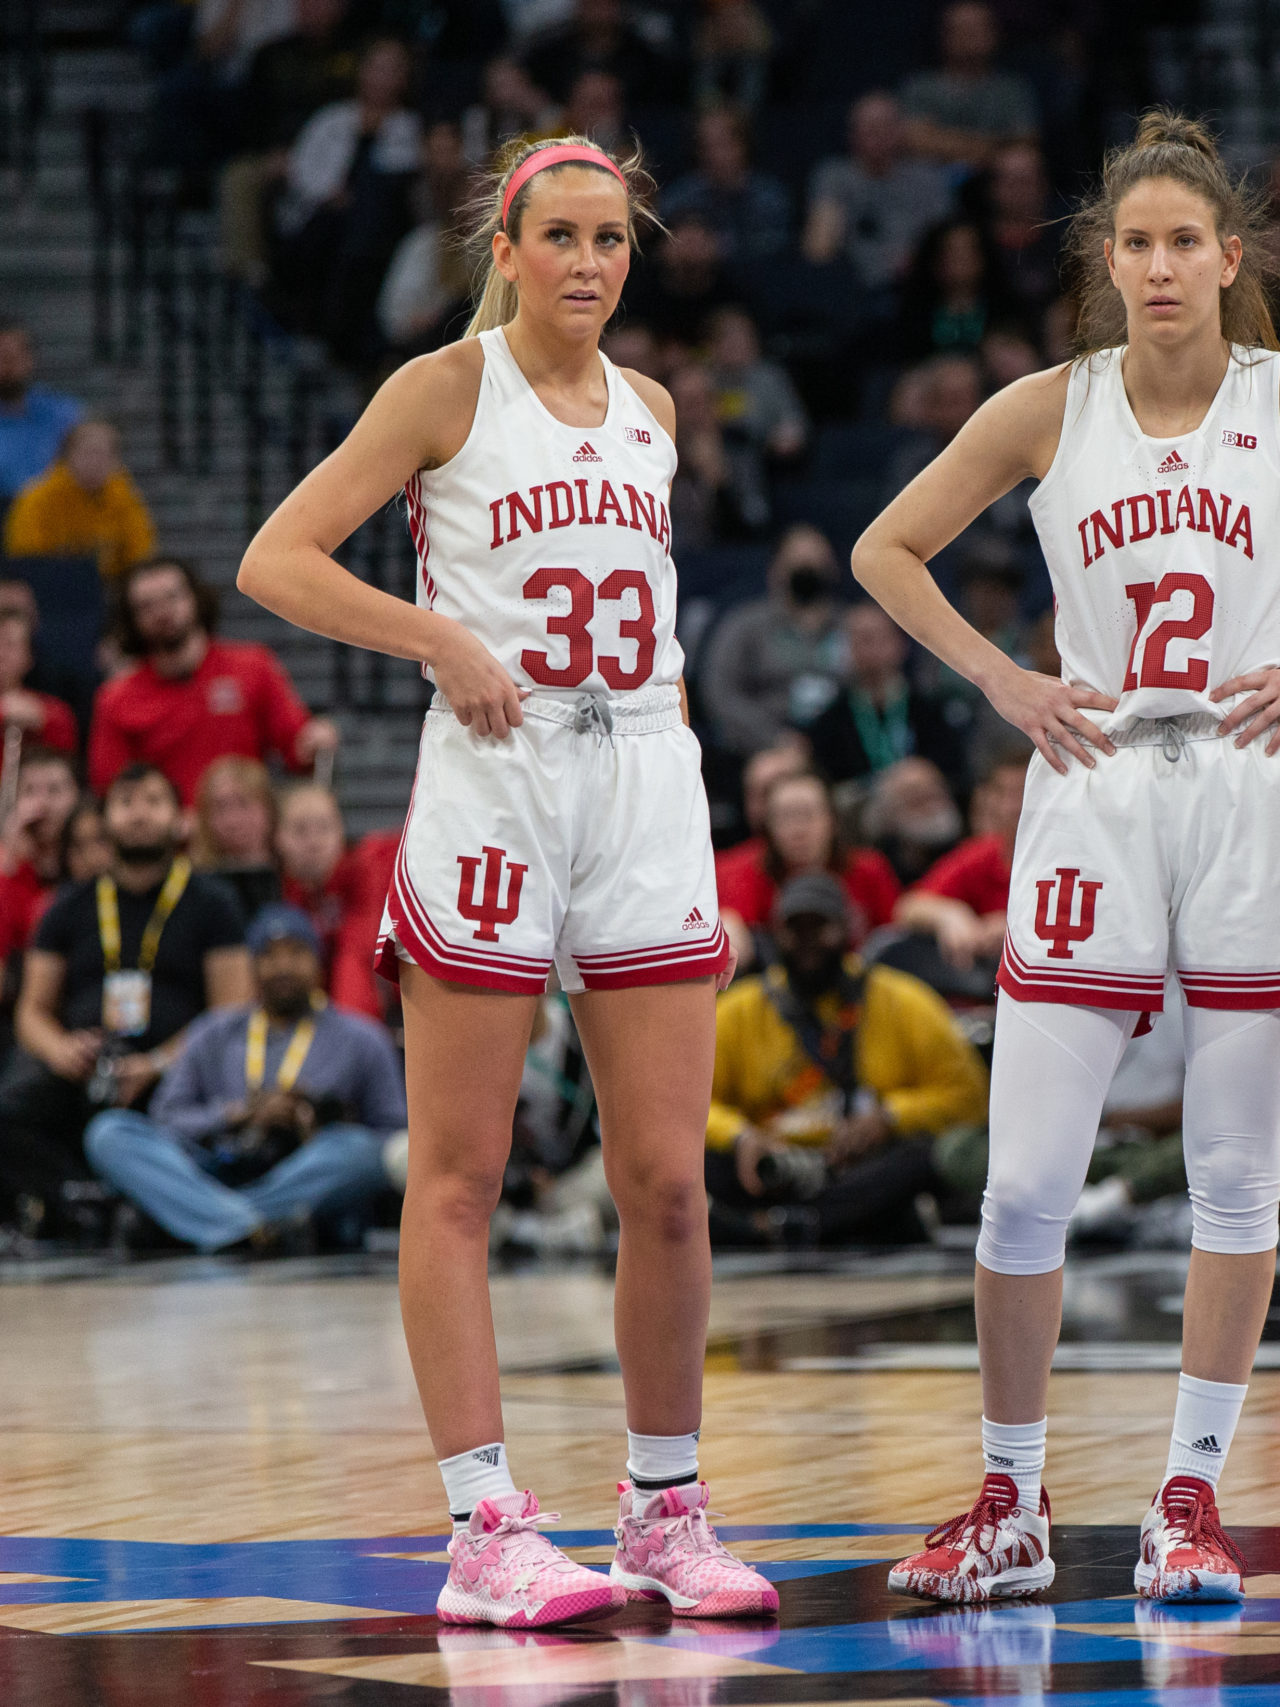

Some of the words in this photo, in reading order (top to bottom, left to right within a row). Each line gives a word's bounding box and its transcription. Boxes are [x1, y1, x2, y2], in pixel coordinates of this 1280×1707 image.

[572, 454, 603, 462] adidas
[1157, 461, 1189, 474] adidas
[489, 478, 670, 558] INDIANA
[1078, 484, 1254, 569] INDIANA
[520, 567, 657, 690] 33
[1123, 572, 1215, 692] 12
[681, 920, 710, 931] adidas
[1191, 1442, 1222, 1453] adidas
